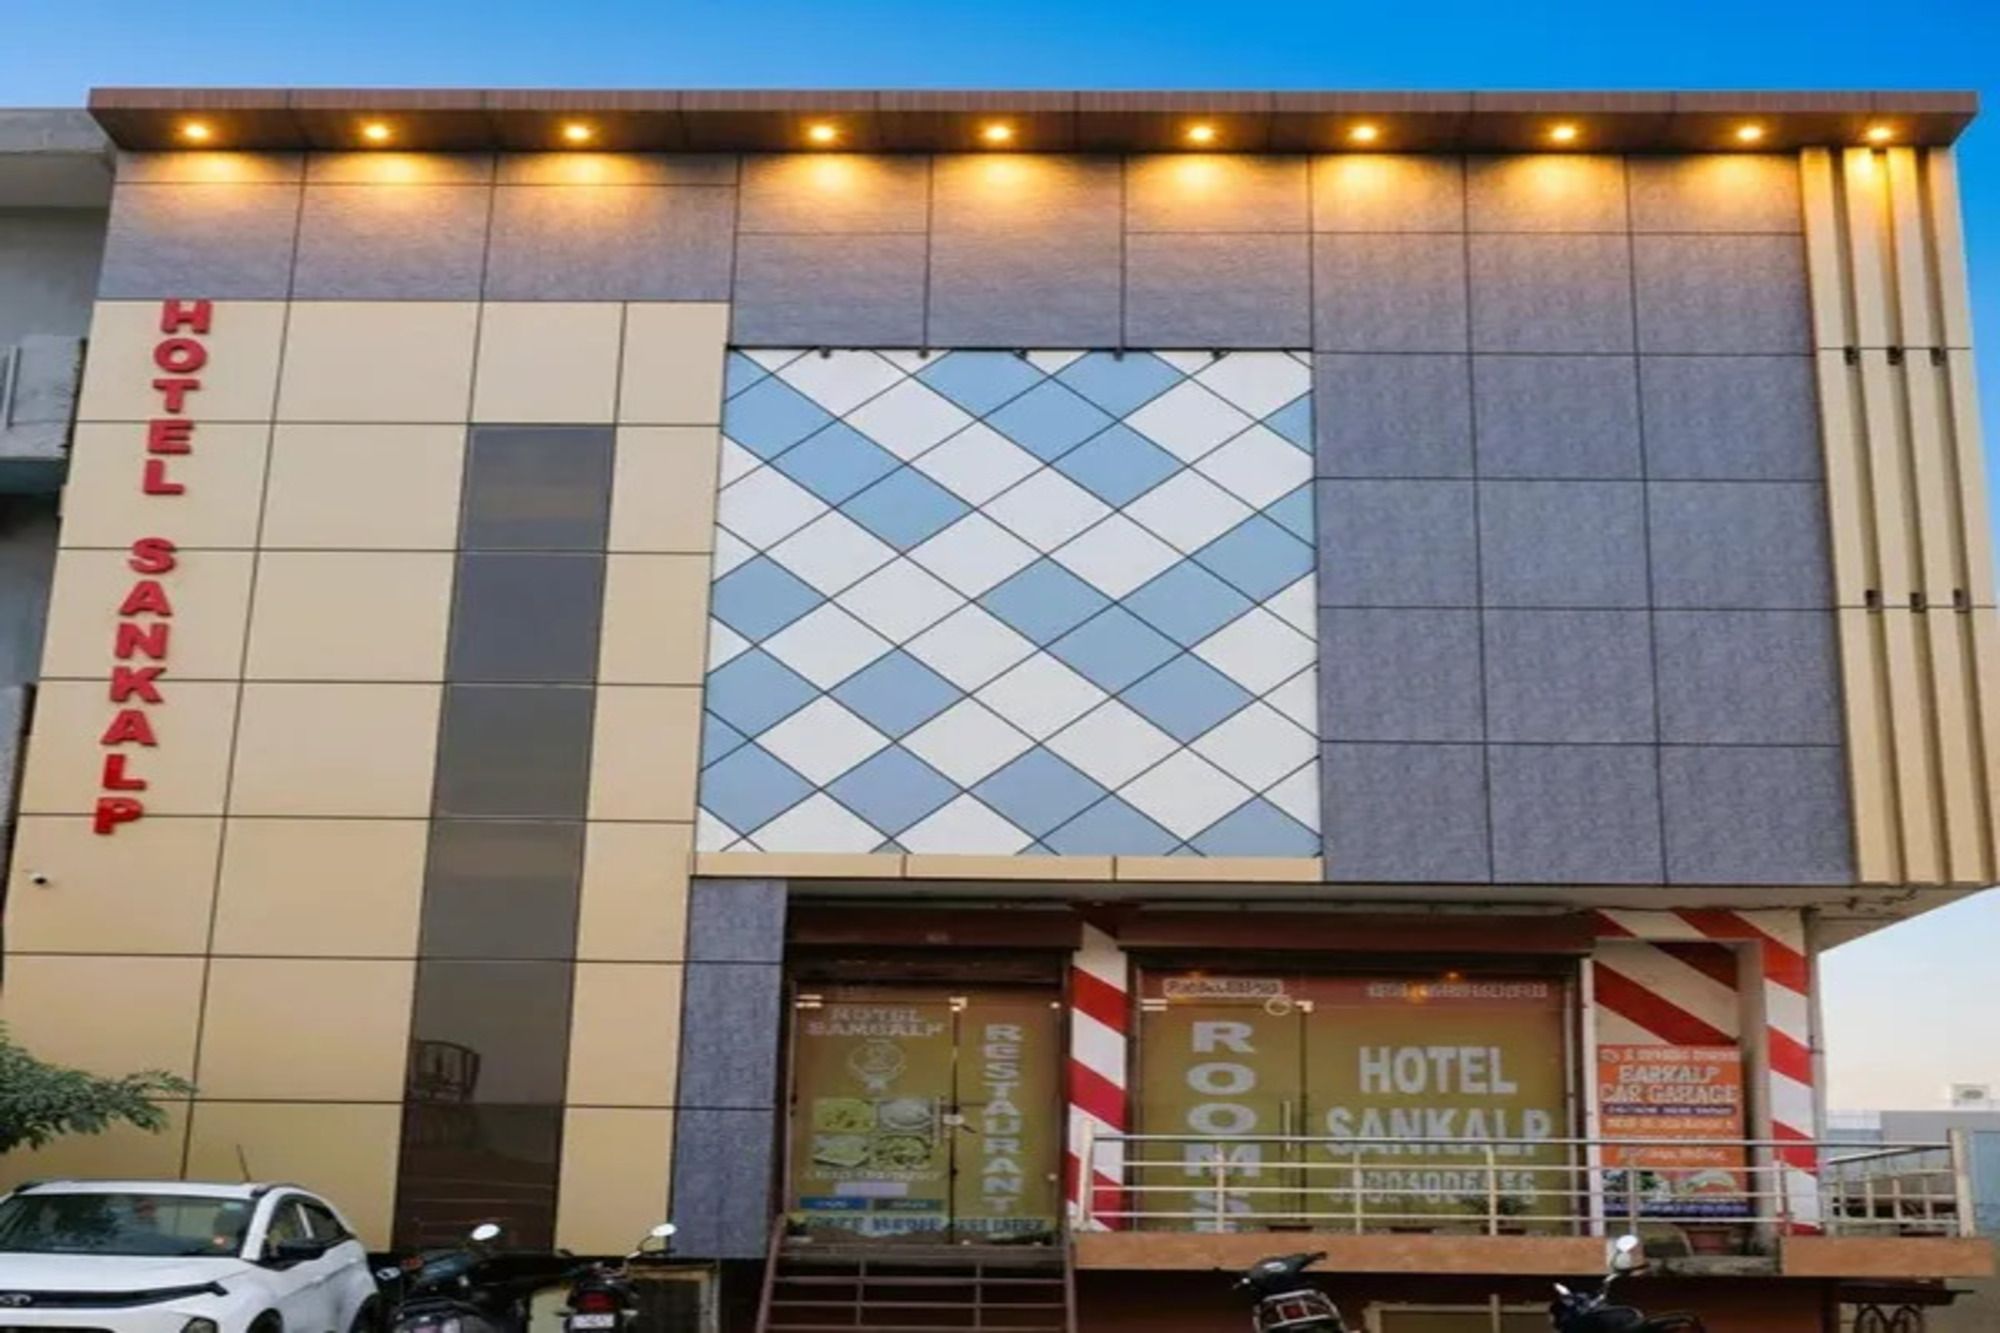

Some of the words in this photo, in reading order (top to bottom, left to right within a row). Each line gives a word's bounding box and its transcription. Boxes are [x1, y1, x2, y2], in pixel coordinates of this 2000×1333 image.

[143, 297, 214, 496] HOTEL
[94, 537, 178, 836] SANKALP
[982, 1023, 1025, 1213] RESTAURANT
[1325, 1107, 1552, 1157] SANKALP
[1358, 1046, 1518, 1094] HOTEL
